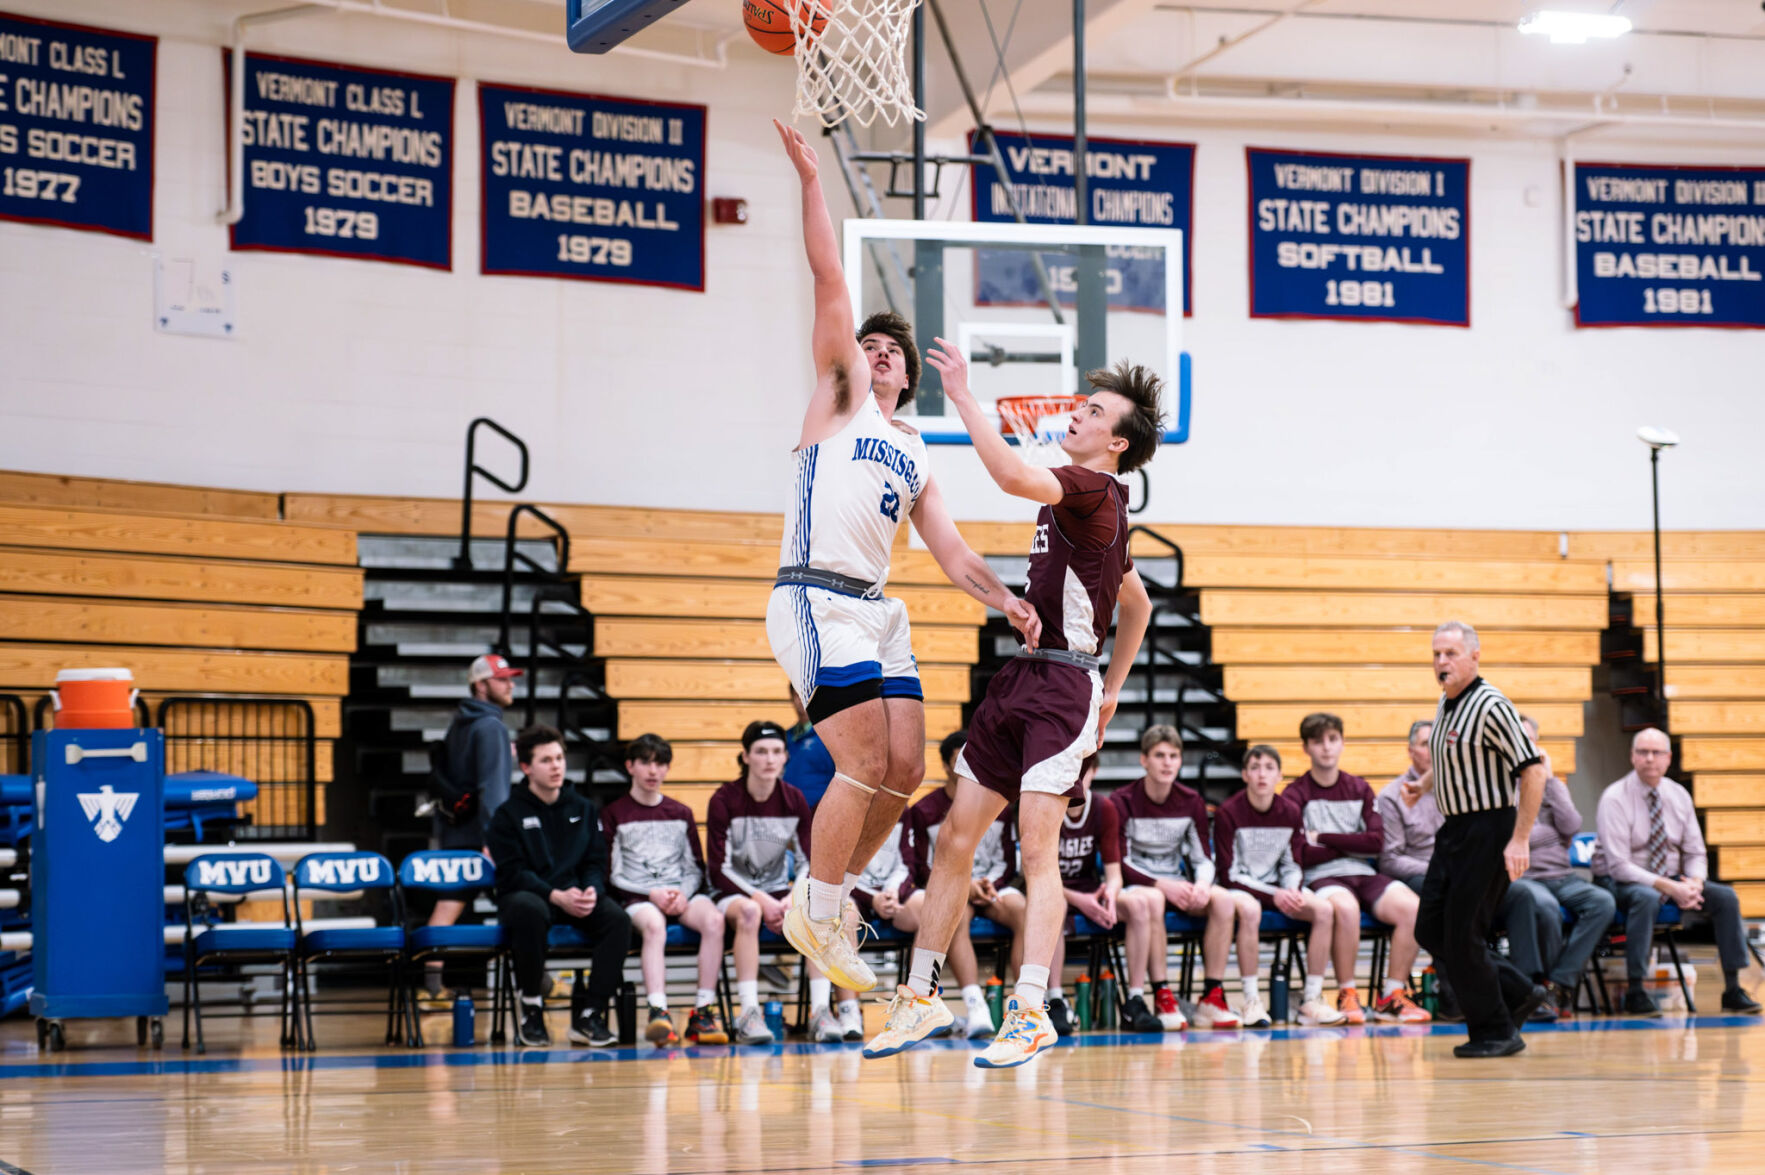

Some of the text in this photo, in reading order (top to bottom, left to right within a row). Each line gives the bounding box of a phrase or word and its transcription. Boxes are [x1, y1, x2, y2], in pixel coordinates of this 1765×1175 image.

[50, 41, 108, 76] CLASS
[112, 50, 125, 79] L
[15, 78, 143, 131] CHAMPIONS
[256, 72, 424, 119] VERMONT CLASS L
[243, 109, 441, 168] STATE CHAMPIONS
[504, 102, 683, 146] VERMONT DIVISION II
[28, 128, 136, 171] SOCCER
[492, 141, 695, 193] STATE CHAMPIONS
[3, 167, 81, 203] 1977
[251, 160, 433, 207] BOYS SOCCER
[1274, 163, 1445, 197] VERMONT DIVISION I
[1586, 176, 1668, 204] VERMONT
[1675, 179, 1748, 206] DIVISION
[304, 206, 378, 240] 1979
[509, 190, 679, 231] BASEBALL
[1093, 188, 1174, 225] CHAMPIONS
[1258, 199, 1460, 240] STATE CHAMPIONS
[1576, 210, 1765, 247] STATE CHAMPION
[557, 234, 632, 267] 1979
[1277, 242, 1444, 275] SOFTBALL
[1593, 252, 1762, 281] BASEBALL
[1325, 280, 1395, 307] 1981
[1643, 287, 1713, 314] 1981
[198, 860, 272, 885] MVU
[307, 857, 380, 884] MVU
[412, 857, 483, 883] MVU
